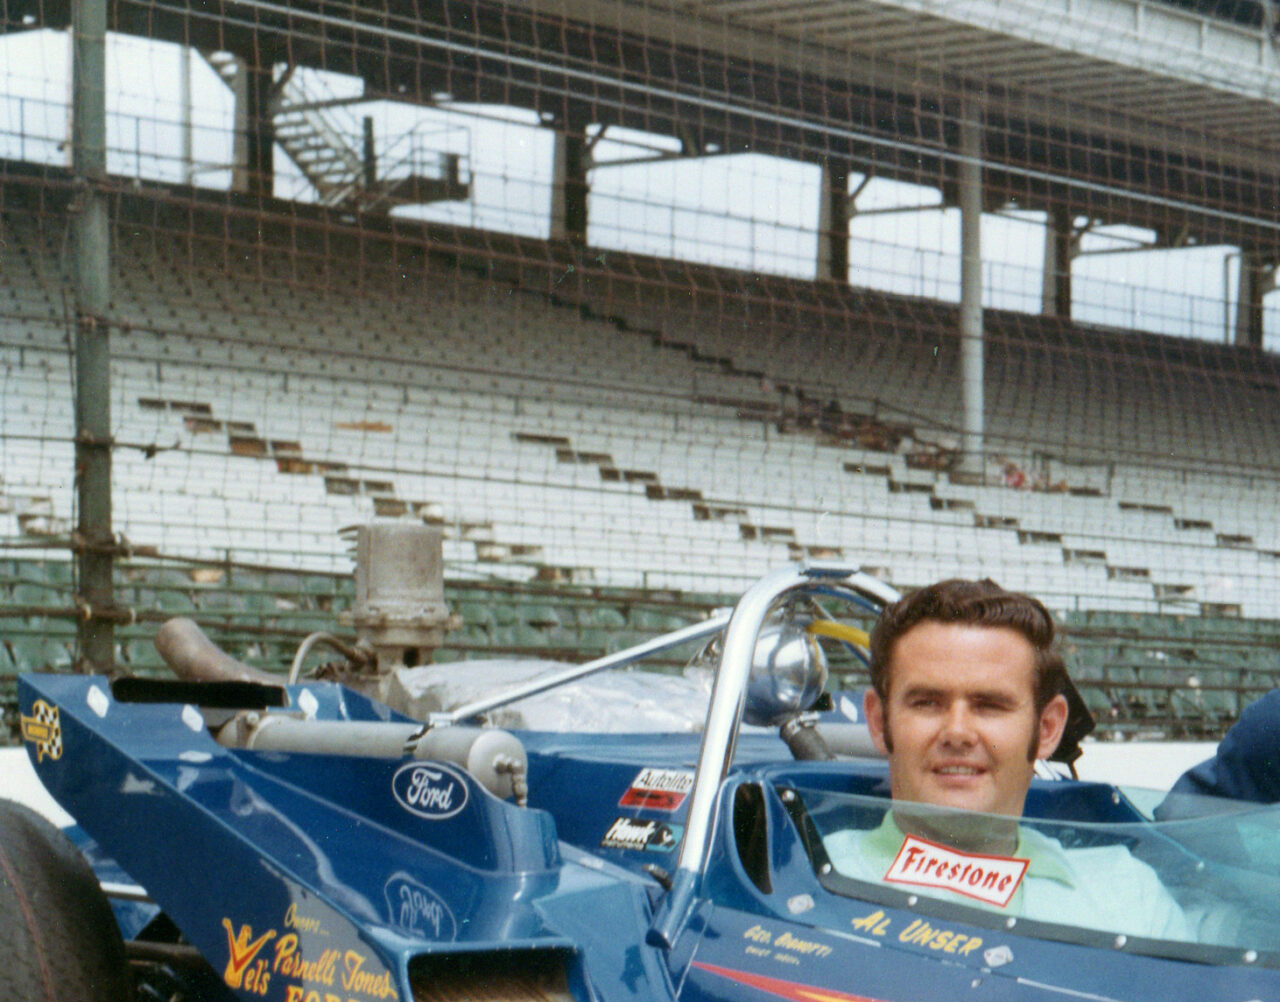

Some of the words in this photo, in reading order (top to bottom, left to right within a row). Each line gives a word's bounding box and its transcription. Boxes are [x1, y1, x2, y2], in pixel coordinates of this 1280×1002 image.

[407, 767, 454, 810] Ford
[899, 846, 1012, 892] Firestone
[852, 910, 891, 935] AL
[898, 919, 983, 956] UNSER
[273, 933, 341, 987] Parnelli
